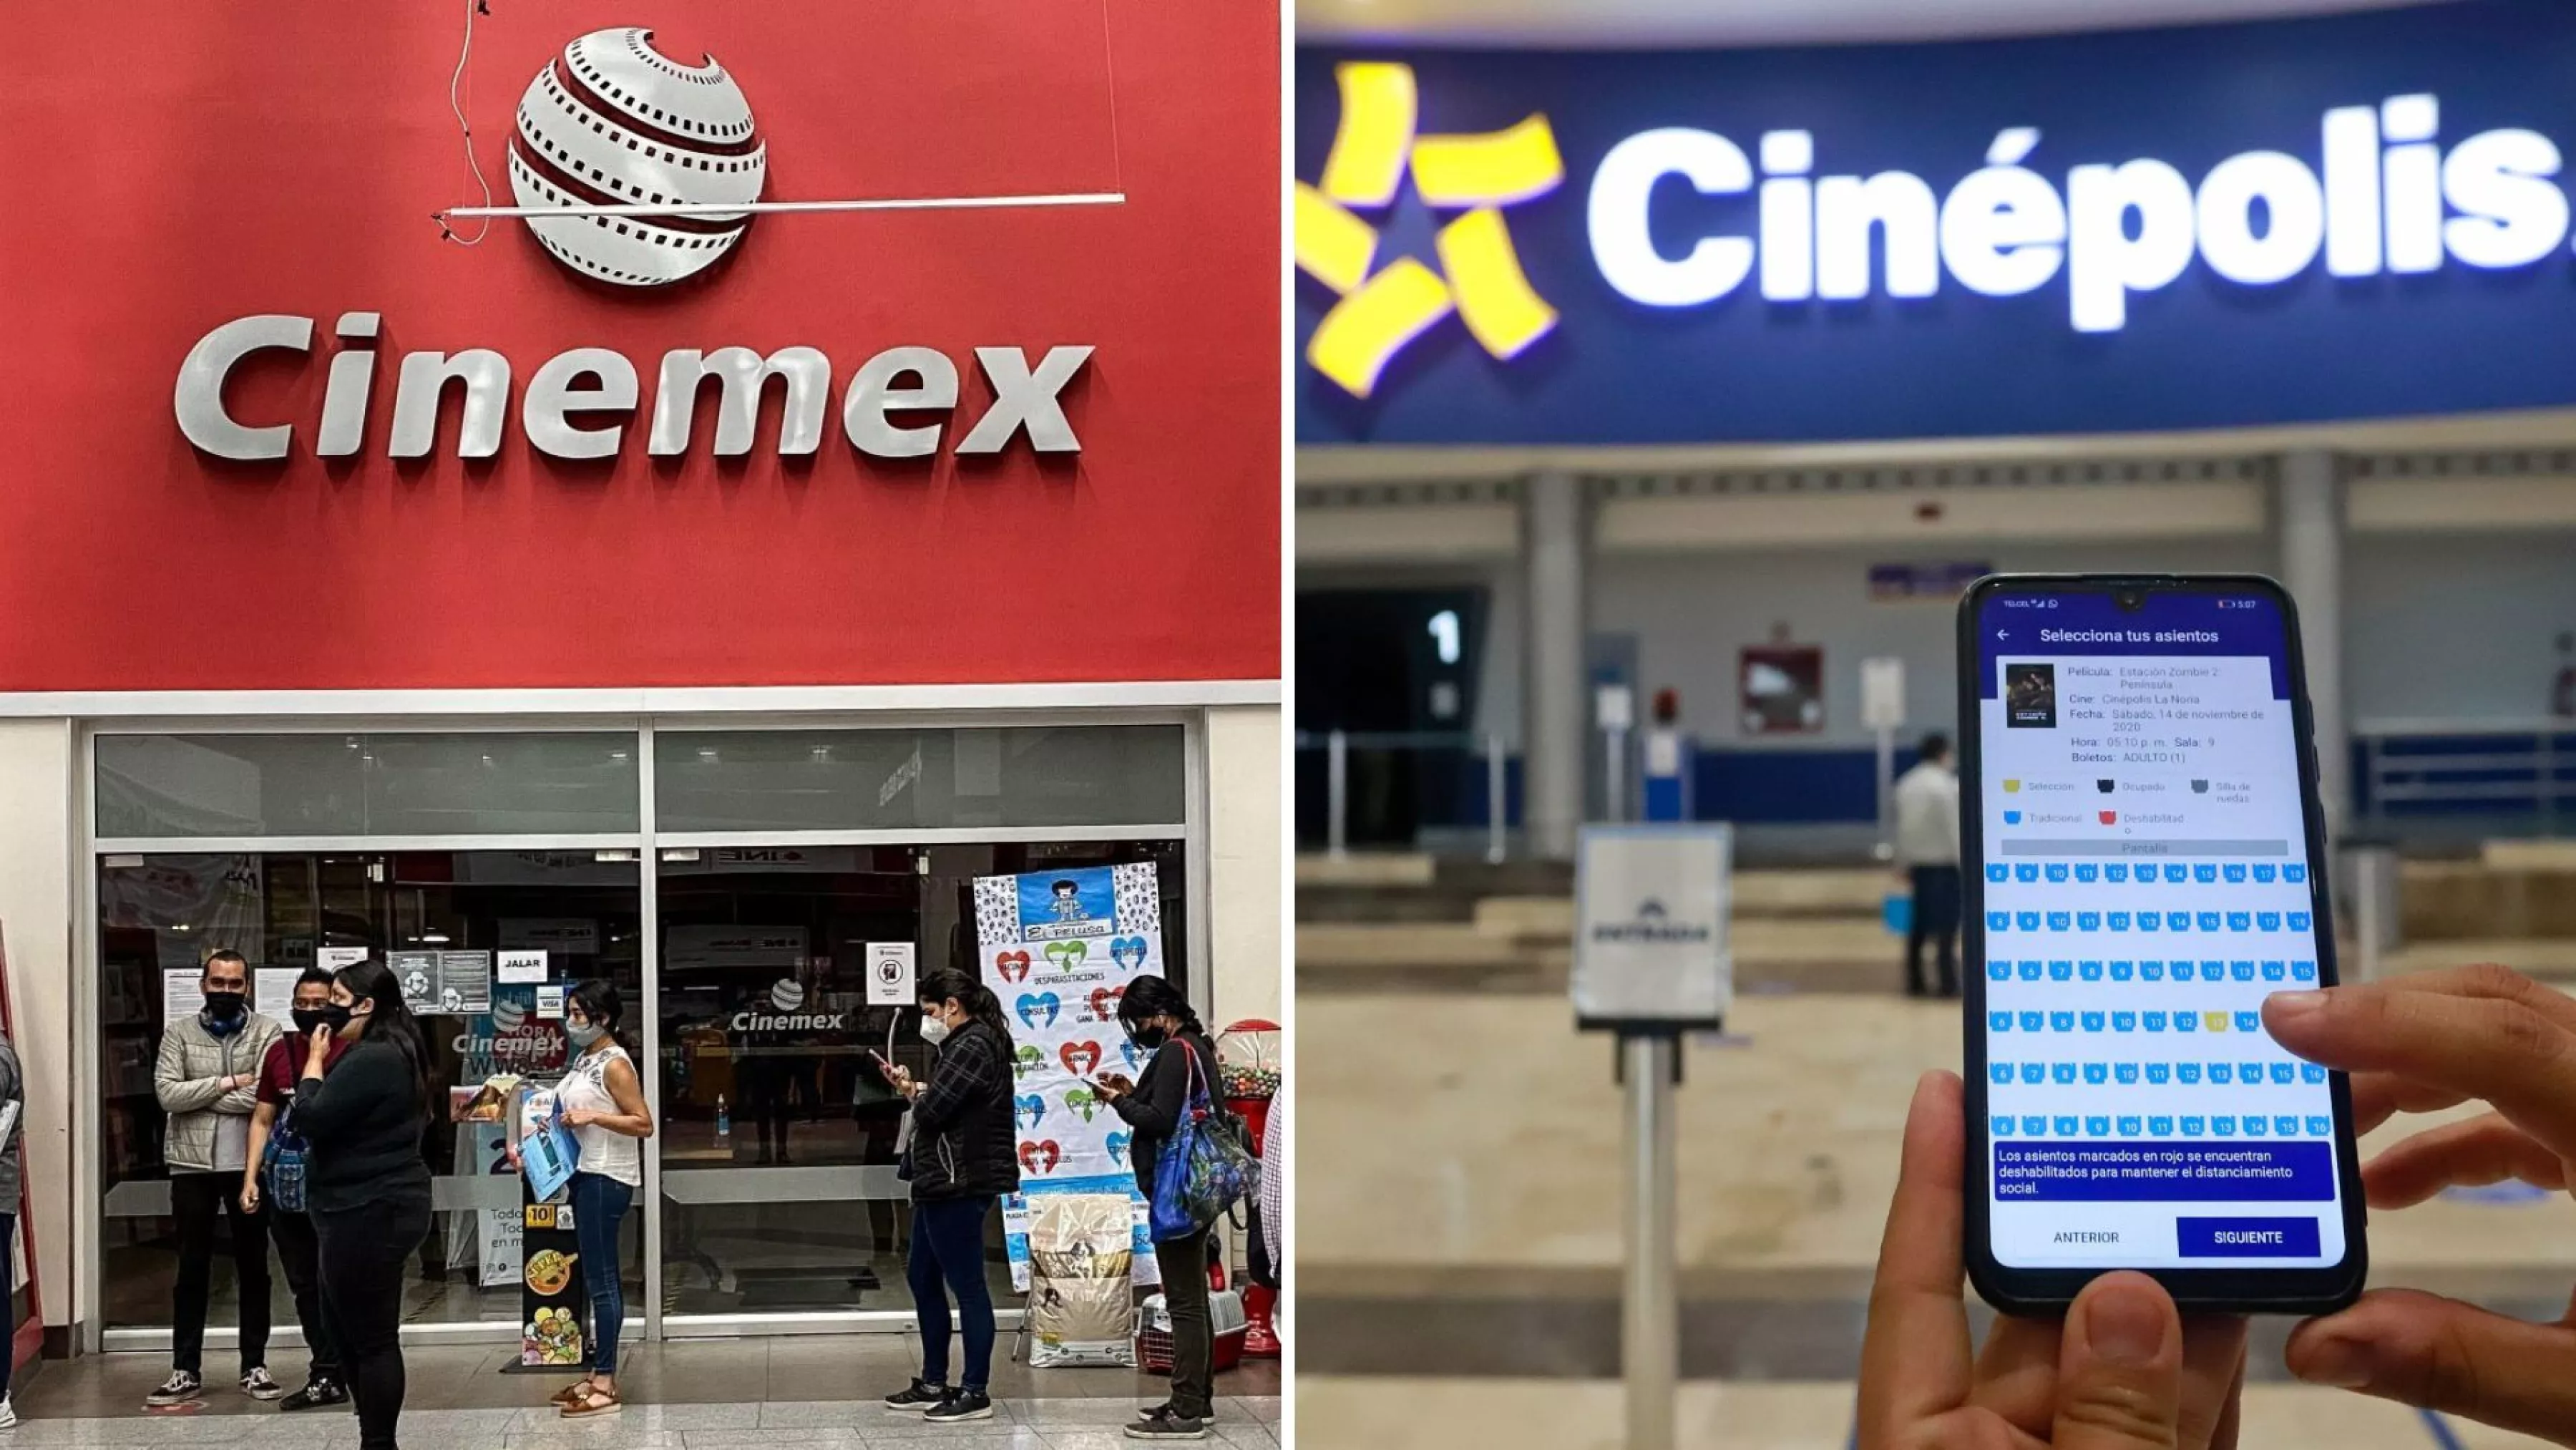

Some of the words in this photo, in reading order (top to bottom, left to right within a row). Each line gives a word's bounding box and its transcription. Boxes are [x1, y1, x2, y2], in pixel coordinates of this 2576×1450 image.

[174, 311, 1096, 460] Cinemex
[1428, 610, 1460, 664] 1
[2040, 628, 2122, 643] Selecciona
[2126, 629, 2150, 643] tus
[2155, 628, 2219, 643] asientos
[2169, 666, 2209, 677] Zombie
[2155, 694, 2168, 704] La
[2160, 709, 2172, 719] 14
[2175, 709, 2189, 719] de
[2192, 709, 2248, 719] noviembre
[2251, 710, 2264, 719] de
[2113, 722, 2141, 732] 2020
[2208, 737, 2215, 746] 9
[2072, 752, 2116, 762] Boletos:
[2123, 753, 2167, 762] ADULTO
[2170, 752, 2185, 764] (1)
[2122, 782, 2165, 793] Ocupado
[2238, 782, 2250, 792] de
[2029, 813, 2082, 823] Tradicional
[2122, 843, 2168, 853] Pantalla
[504, 959, 540, 968] JALAR
[731, 1012, 844, 1031] Cinemex
[452, 1033, 565, 1053] Cinemex
[1999, 1149, 2020, 1162] Los
[2024, 1149, 2076, 1162] asientos
[2079, 1149, 2139, 1162] marcados
[2142, 1153, 2159, 1162] en
[2161, 1150, 2184, 1166] rojo
[2187, 1153, 2201, 1162] se
[2205, 1152, 2271, 1162] encuentran
[1999, 1165, 2088, 1179] deshabilitados
[2091, 1169, 2118, 1182] para
[2121, 1168, 2179, 1179] mantener
[2182, 1166, 2193, 1179] el
[2195, 1165, 2293, 1179] distanciamiento
[1999, 1182, 2039, 1195] social.
[2053, 1231, 2119, 1244] ANTERIOR
[2214, 1230, 2283, 1244] SIGUIENTE
